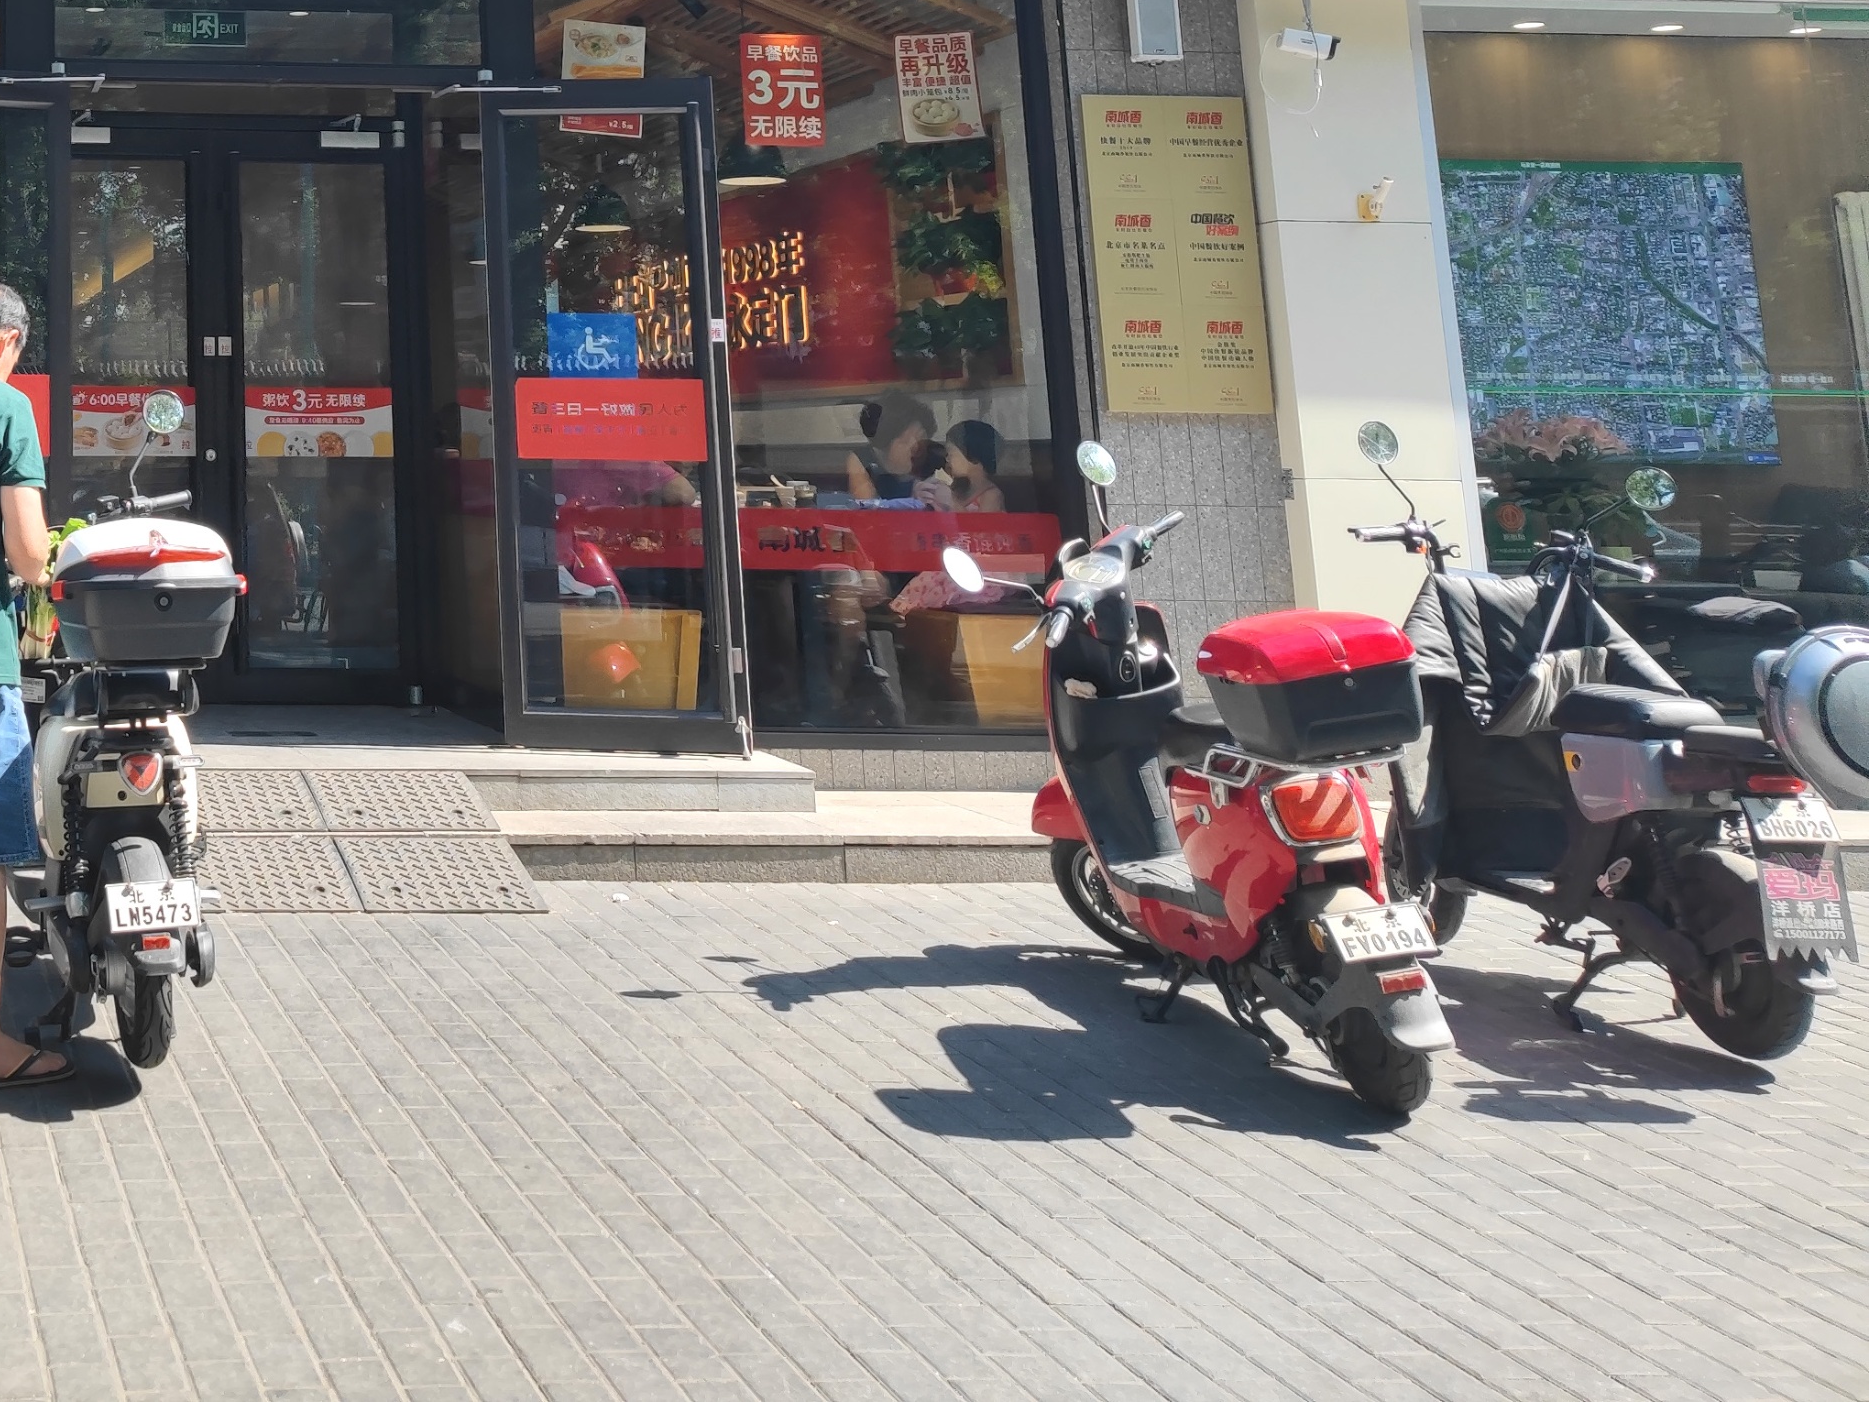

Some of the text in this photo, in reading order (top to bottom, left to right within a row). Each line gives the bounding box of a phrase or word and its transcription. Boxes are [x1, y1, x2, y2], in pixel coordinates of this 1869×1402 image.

[220, 23, 239, 34] EXIT
[899, 36, 967, 54] 早餐品质
[746, 44, 818, 63] 早餐饮品
[899, 53, 970, 77] 再升级
[747, 69, 820, 110] 3元
[1105, 110, 1142, 124] 南城香
[1186, 111, 1222, 125] 南城香
[750, 116, 822, 139] 无限续
[1115, 214, 1152, 227] 南城香
[1125, 320, 1162, 333] 南城香
[1206, 321, 1244, 334] 南城香
[89, 393, 150, 407] 6:00早餐
[326, 393, 366, 407] 无限续
[115, 903, 192, 927] LN5473
[1771, 901, 1842, 918] 洋桥店
[1341, 928, 1427, 958] FV0194
